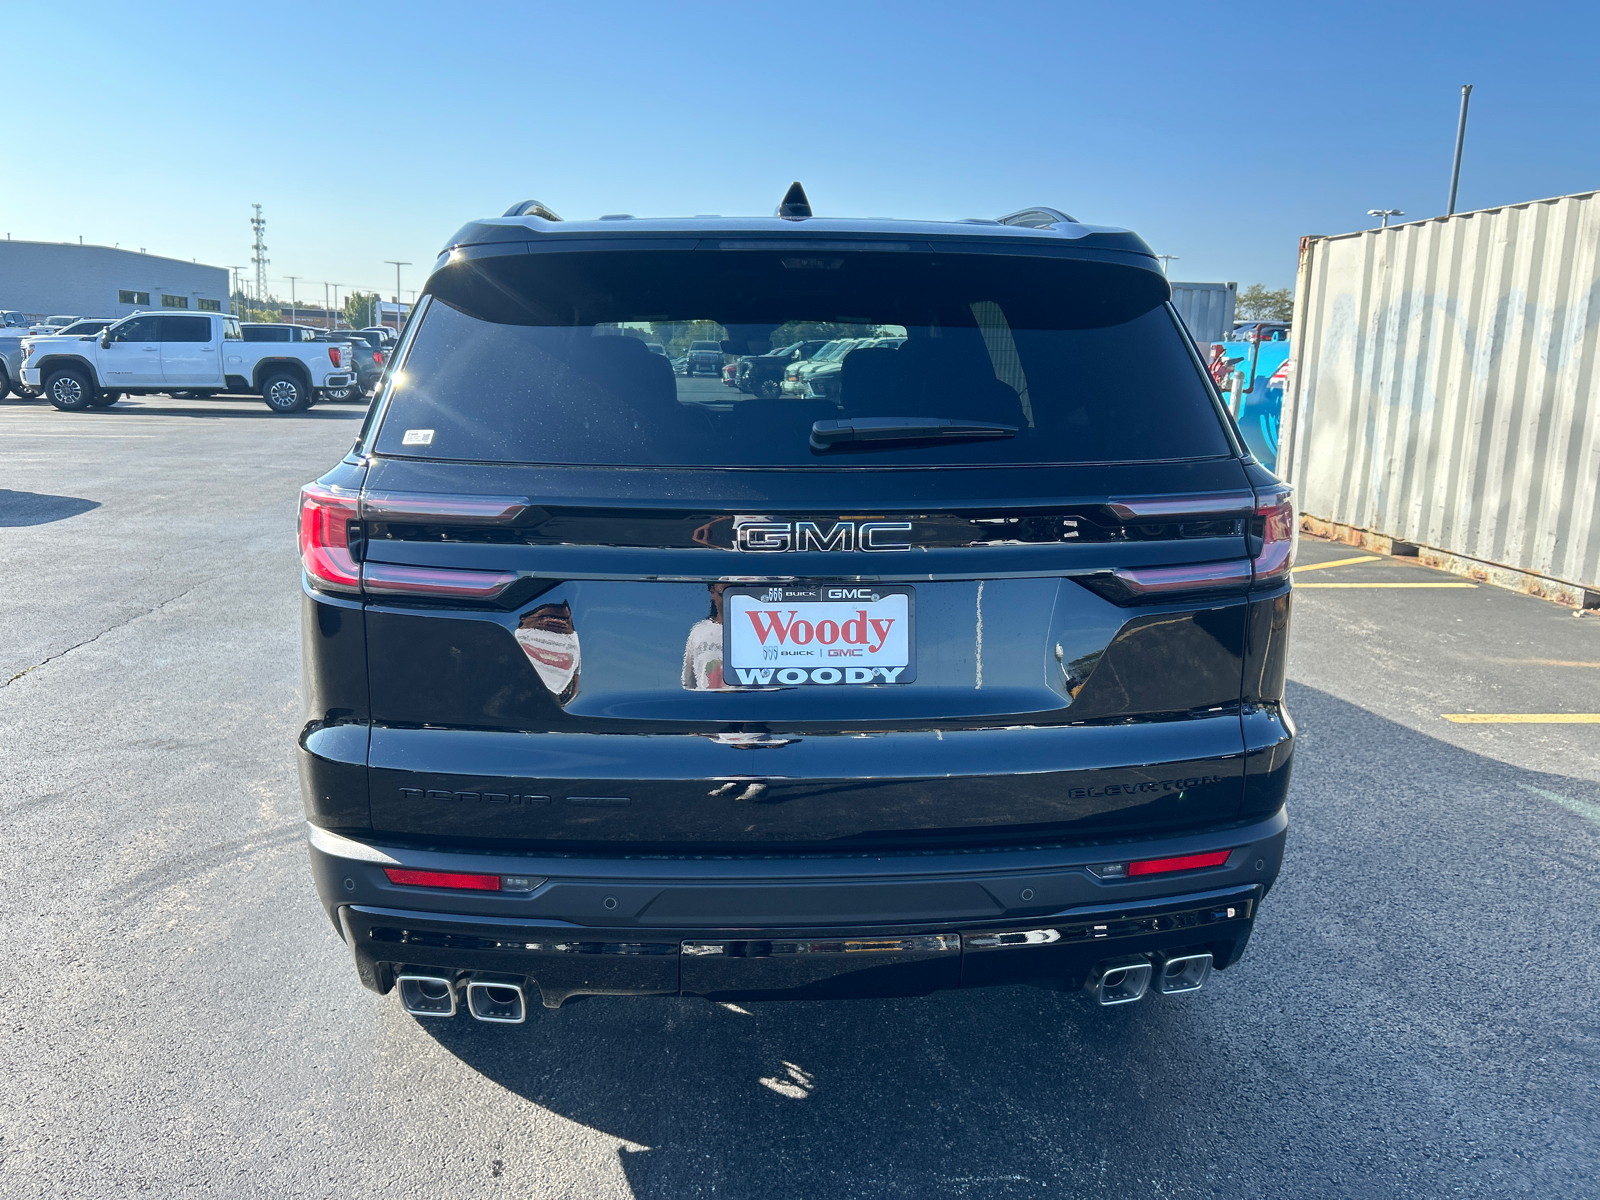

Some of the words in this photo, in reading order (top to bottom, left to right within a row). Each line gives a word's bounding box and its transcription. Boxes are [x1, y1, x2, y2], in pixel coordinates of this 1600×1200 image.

[737, 522, 912, 552] GMC
[828, 589, 871, 599] GMC
[745, 610, 895, 653] Woody
[828, 648, 863, 657] GMC
[735, 667, 905, 685] WOODY
